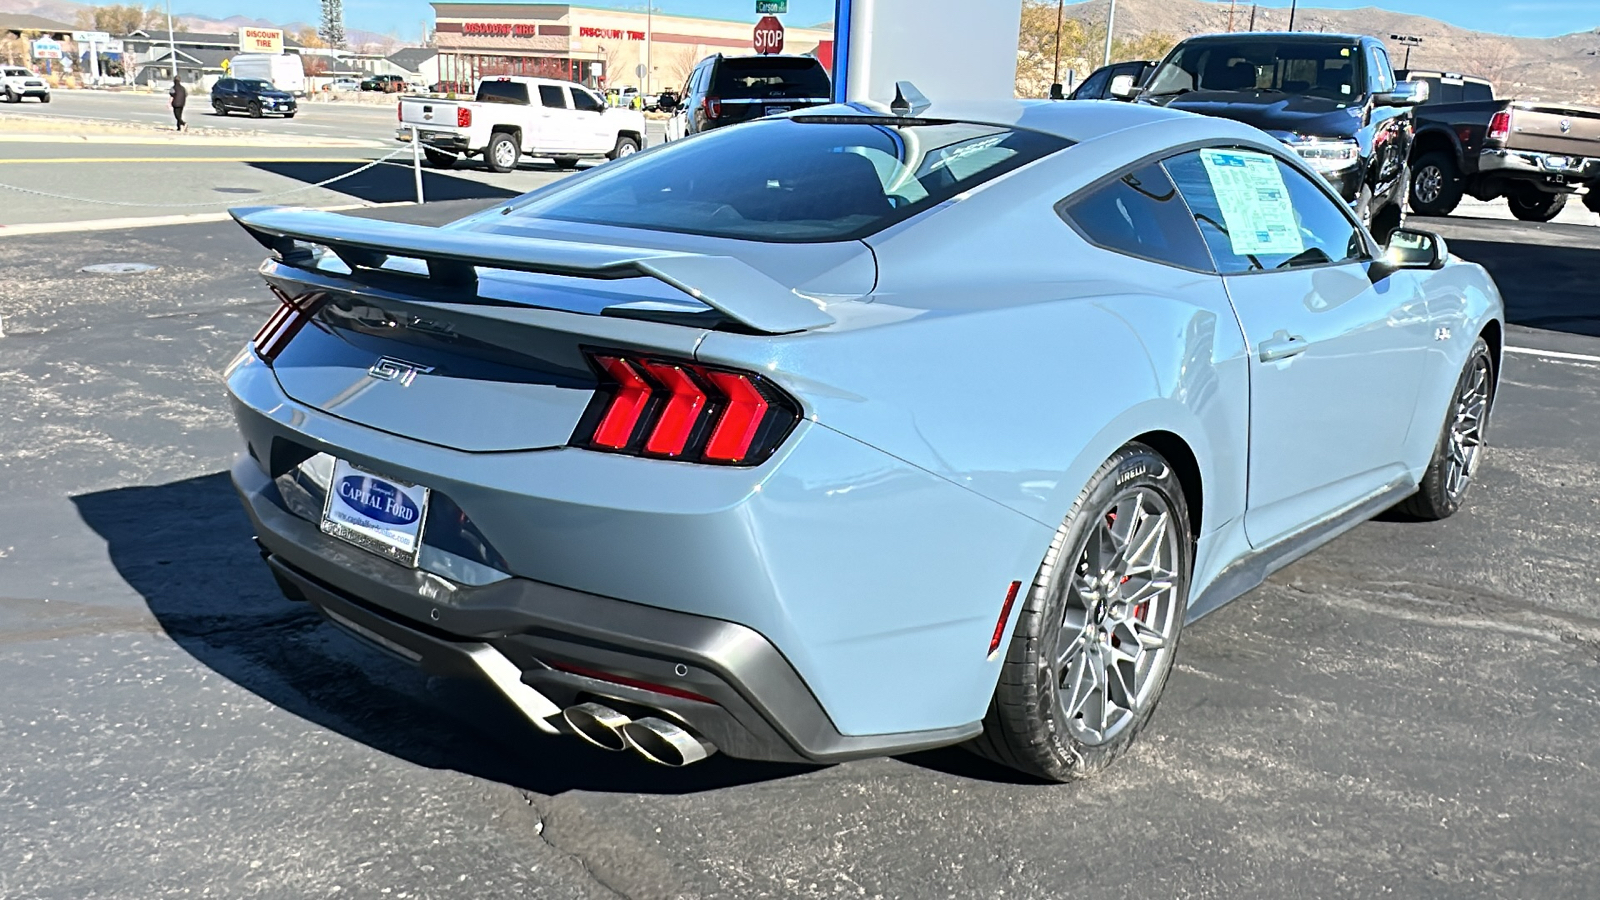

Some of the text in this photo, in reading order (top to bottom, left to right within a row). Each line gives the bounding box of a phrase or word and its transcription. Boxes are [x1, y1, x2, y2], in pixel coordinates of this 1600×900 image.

[759, 2, 777, 12] Carson
[246, 30, 279, 39] DISCOUNT
[464, 23, 535, 35] DISCOUNT TIRE
[580, 27, 646, 41] DISCOUNT TIRE
[256, 39, 272, 48] TIRE
[755, 29, 783, 48] STOP
[368, 355, 435, 388] GT
